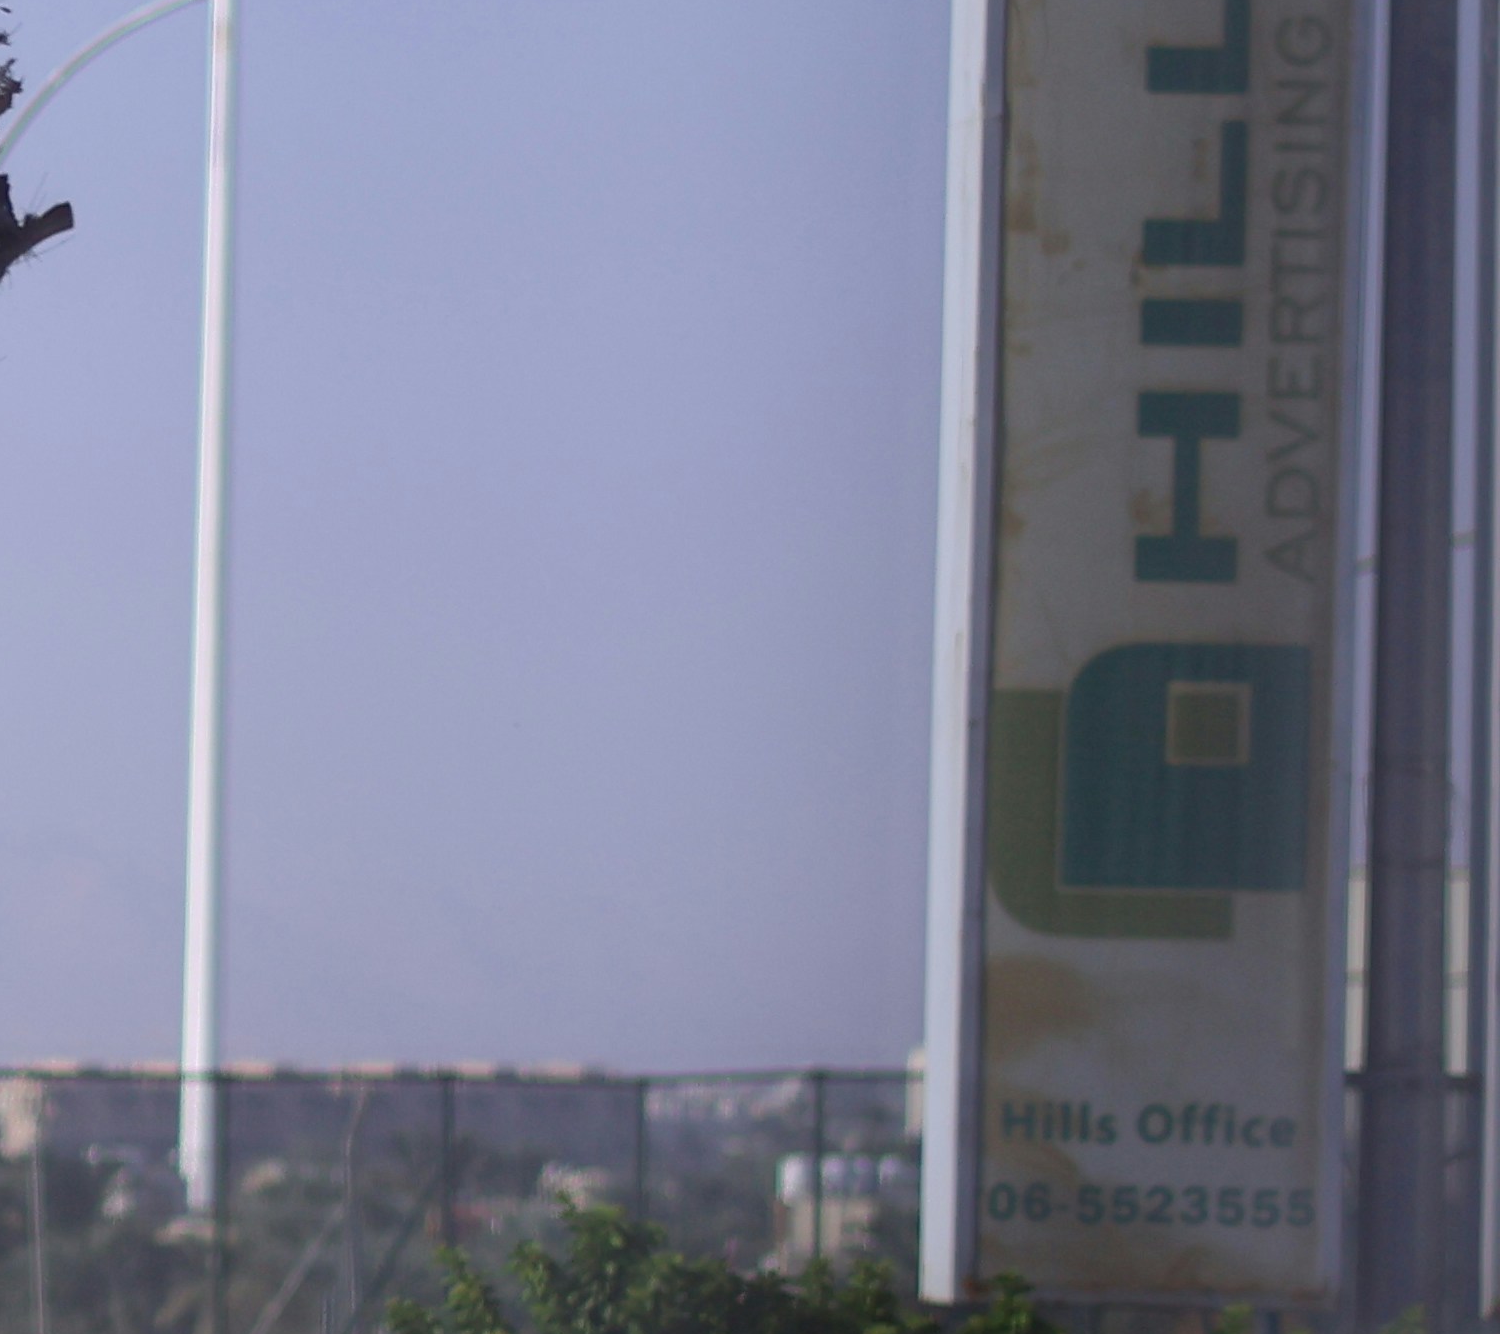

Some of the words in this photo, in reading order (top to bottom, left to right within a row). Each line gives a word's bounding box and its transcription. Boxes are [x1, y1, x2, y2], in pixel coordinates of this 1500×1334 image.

[1264, 16, 1335, 583] ADVERTISING
[1002, 1101, 1117, 1145] Hills
[1137, 1103, 1297, 1147] Office
[987, 1182, 1316, 1227] 06-5523555
